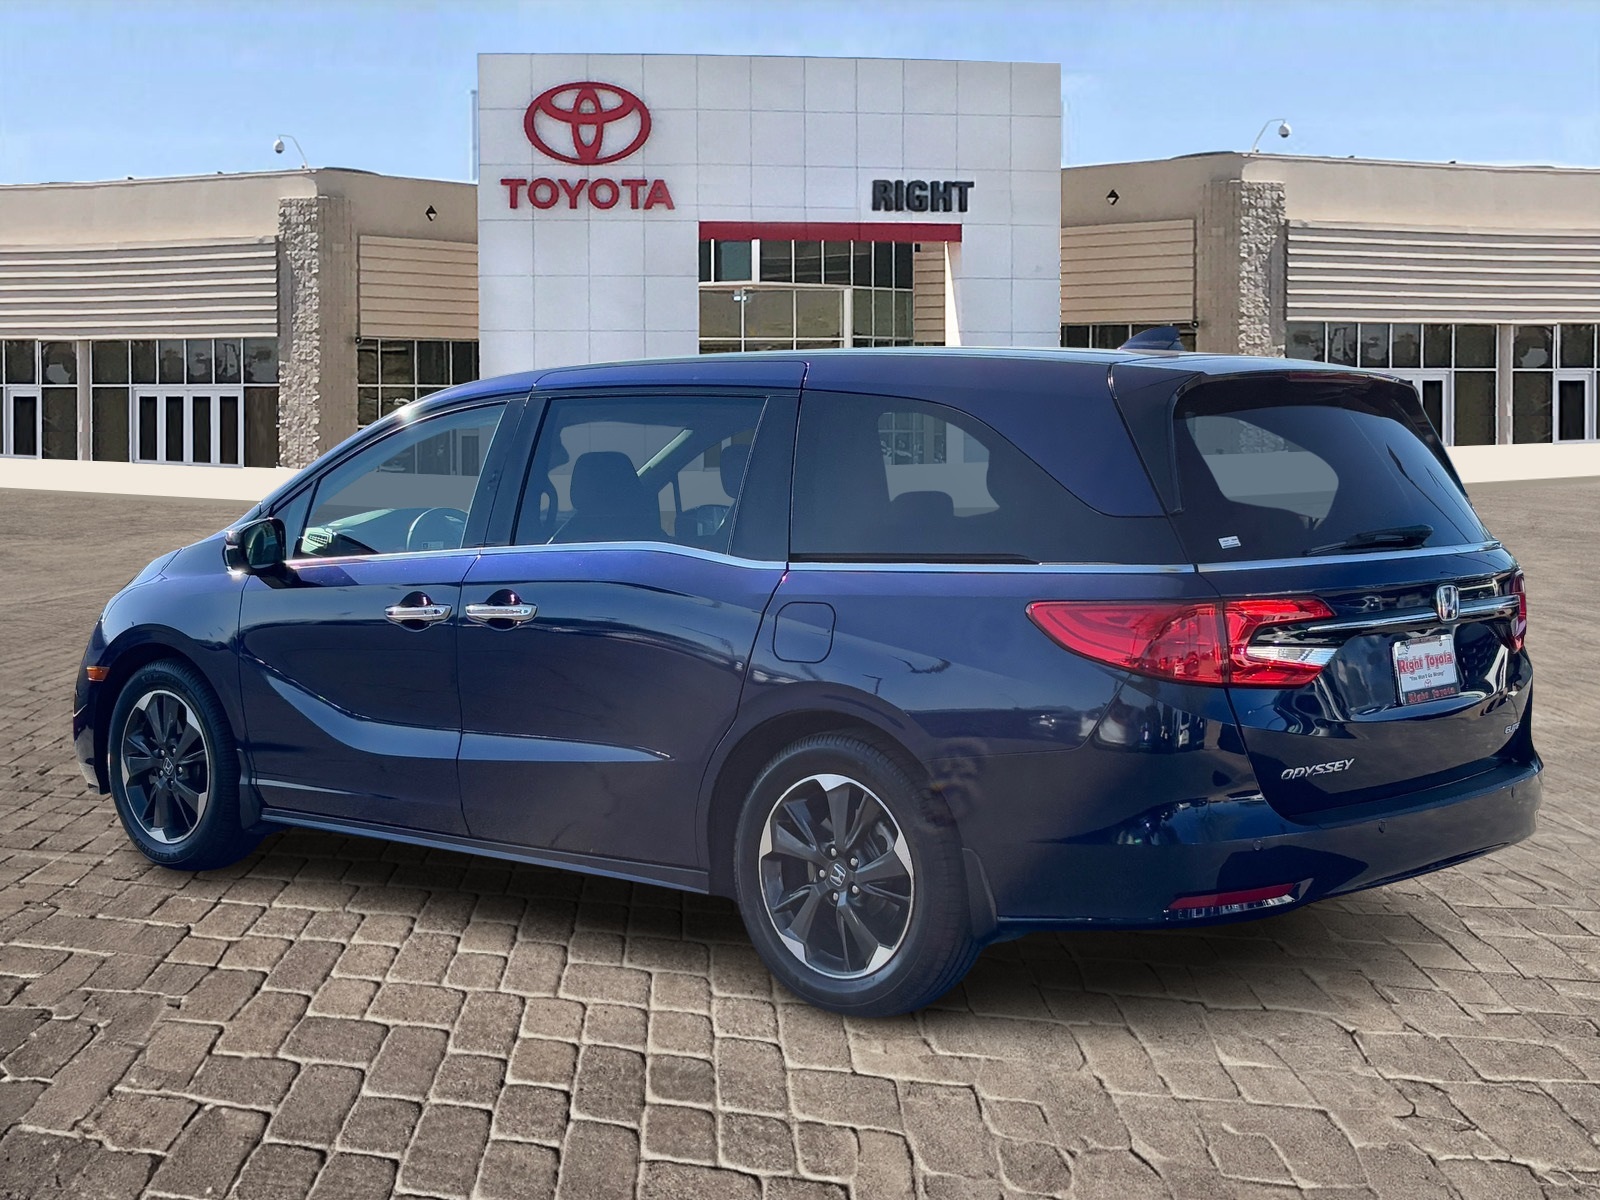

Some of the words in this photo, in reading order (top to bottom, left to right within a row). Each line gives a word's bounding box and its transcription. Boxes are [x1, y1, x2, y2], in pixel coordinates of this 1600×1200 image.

[501, 178, 675, 211] TOYOTA
[872, 179, 975, 213] RIGHT
[1397, 656, 1423, 674] Right
[1425, 652, 1453, 670] Toyota
[1408, 691, 1429, 703] Right
[1281, 758, 1355, 780] ODYSSEY
